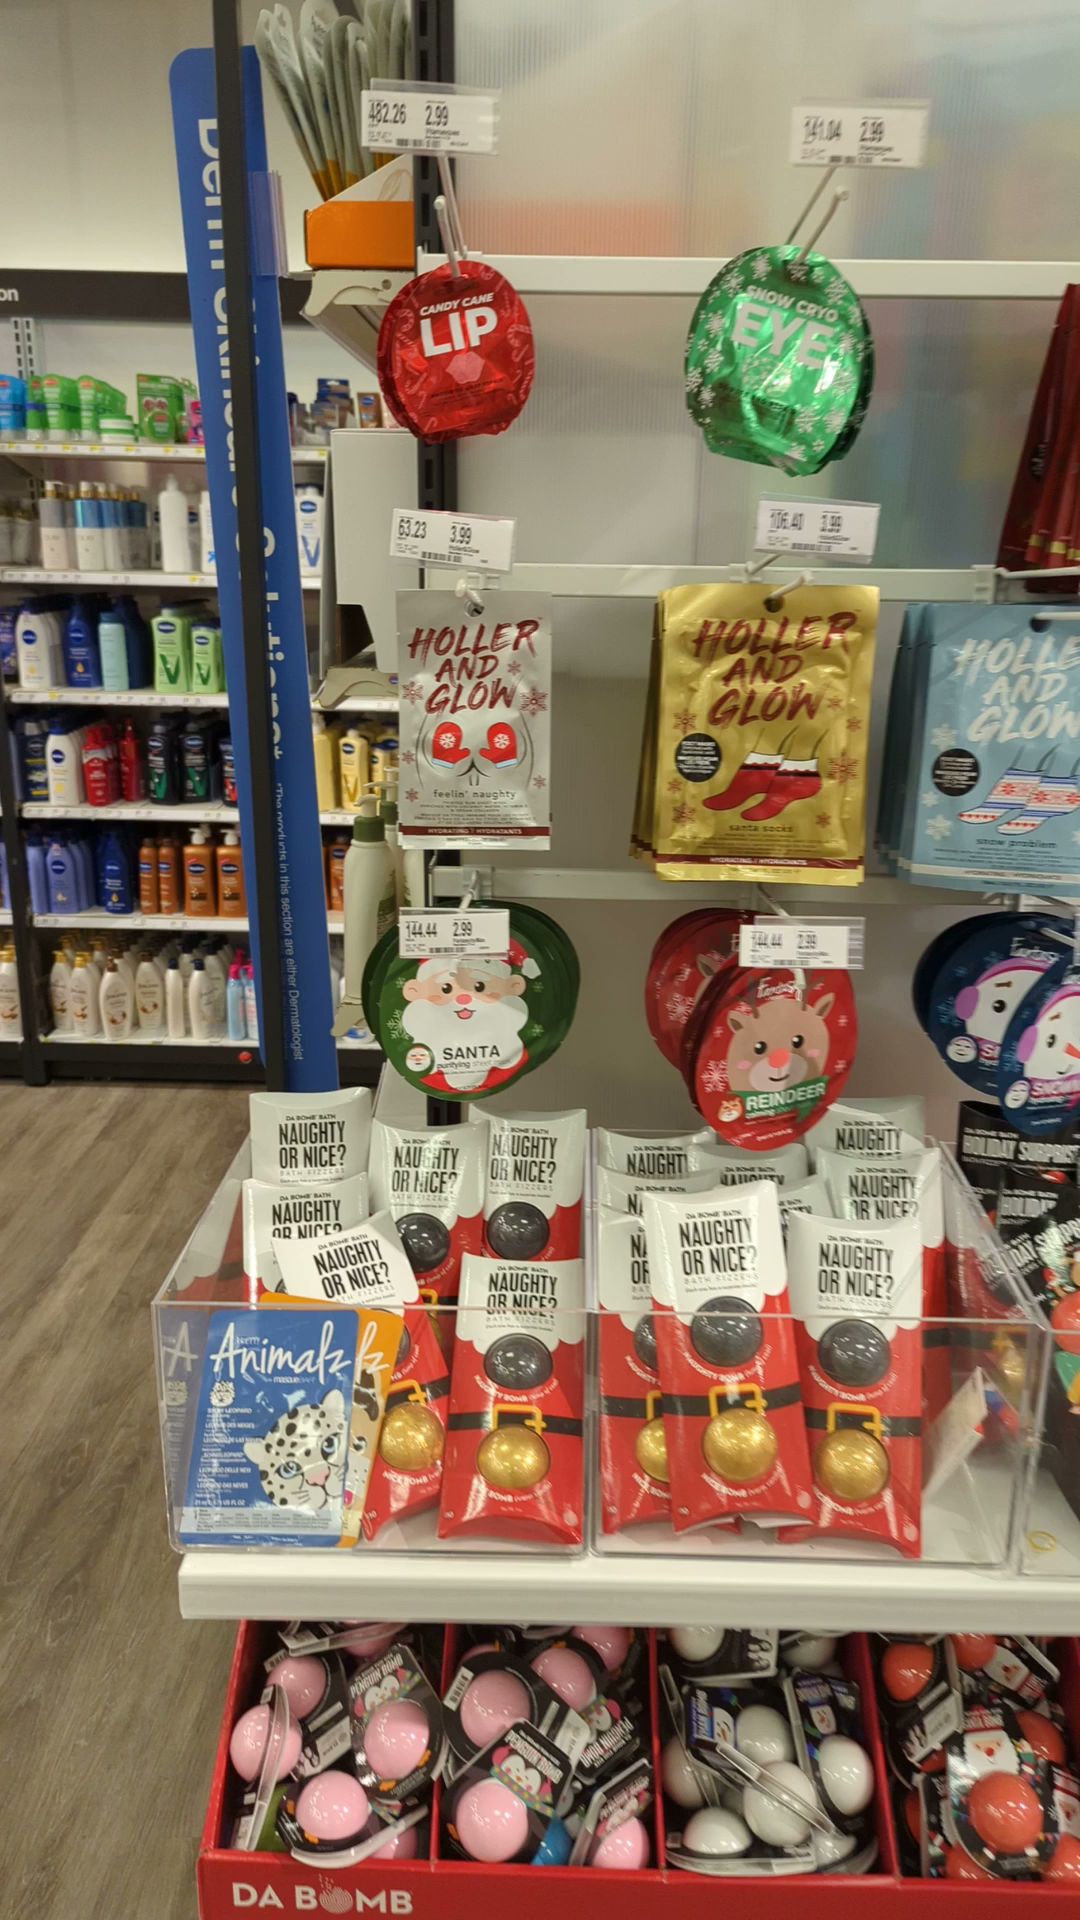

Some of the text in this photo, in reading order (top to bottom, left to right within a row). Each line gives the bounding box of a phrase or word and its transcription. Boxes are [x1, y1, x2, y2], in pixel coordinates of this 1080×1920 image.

[368, 102, 449, 127] 482.26 2.99
[420, 292, 494, 317] CANDY CANE
[747, 285, 839, 323] SNOW CRYO
[420, 306, 498, 357] LIP
[731, 302, 834, 369] EYE
[398, 518, 472, 544] 63.23 3.99
[408, 618, 540, 668] HOLLER
[693, 611, 858, 660] HOLLER
[435, 654, 500, 687] AND
[723, 655, 804, 688] AND
[954, 635, 1080, 685] HOLLE
[425, 677, 517, 715] GLOW
[982, 673, 1069, 707] AND
[708, 683, 829, 728] GLOW
[967, 700, 1080, 743] GLOW
[472, 789, 517, 801] naughty
[729, 824, 793, 833] santa socks
[280, 876, 291, 895] this
[281, 898, 294, 936] section
[406, 921, 473, 938] 144.44 2.99
[284, 938, 294, 956] are
[286, 958, 298, 988] either
[289, 990, 304, 1060] Dermatologist
[443, 1045, 500, 1061] SANTA
[746, 1082, 826, 1111] REINDEER
[279, 1121, 345, 1145] NAUGHTY
[492, 1134, 558, 1159] NAUGHTY
[835, 1127, 902, 1151] NAUGHTY
[279, 1144, 347, 1169] OR NICE?
[394, 1146, 459, 1170] NAUGHTY
[490, 1158, 557, 1184] OR NICE?
[392, 1170, 459, 1195] OR NICE?
[849, 1175, 917, 1199] NAUGHTY
[272, 1200, 341, 1226] NAUGHTY
[679, 1217, 753, 1248] NAUGHTY
[313, 1239, 384, 1276] NAUGHTY
[682, 1244, 758, 1276] OR NICE?
[819, 1242, 894, 1274] NAUGHTY
[321, 1262, 392, 1299] OR NICE?
[489, 1273, 558, 1297] NAUGHTY
[818, 1269, 895, 1300] OR NICE?
[487, 1294, 558, 1319] OR NICE?
[209, 1320, 352, 1385] Animalz
[350, 1667, 383, 1699] PENGUIN
[232, 1882, 284, 1909] DA
